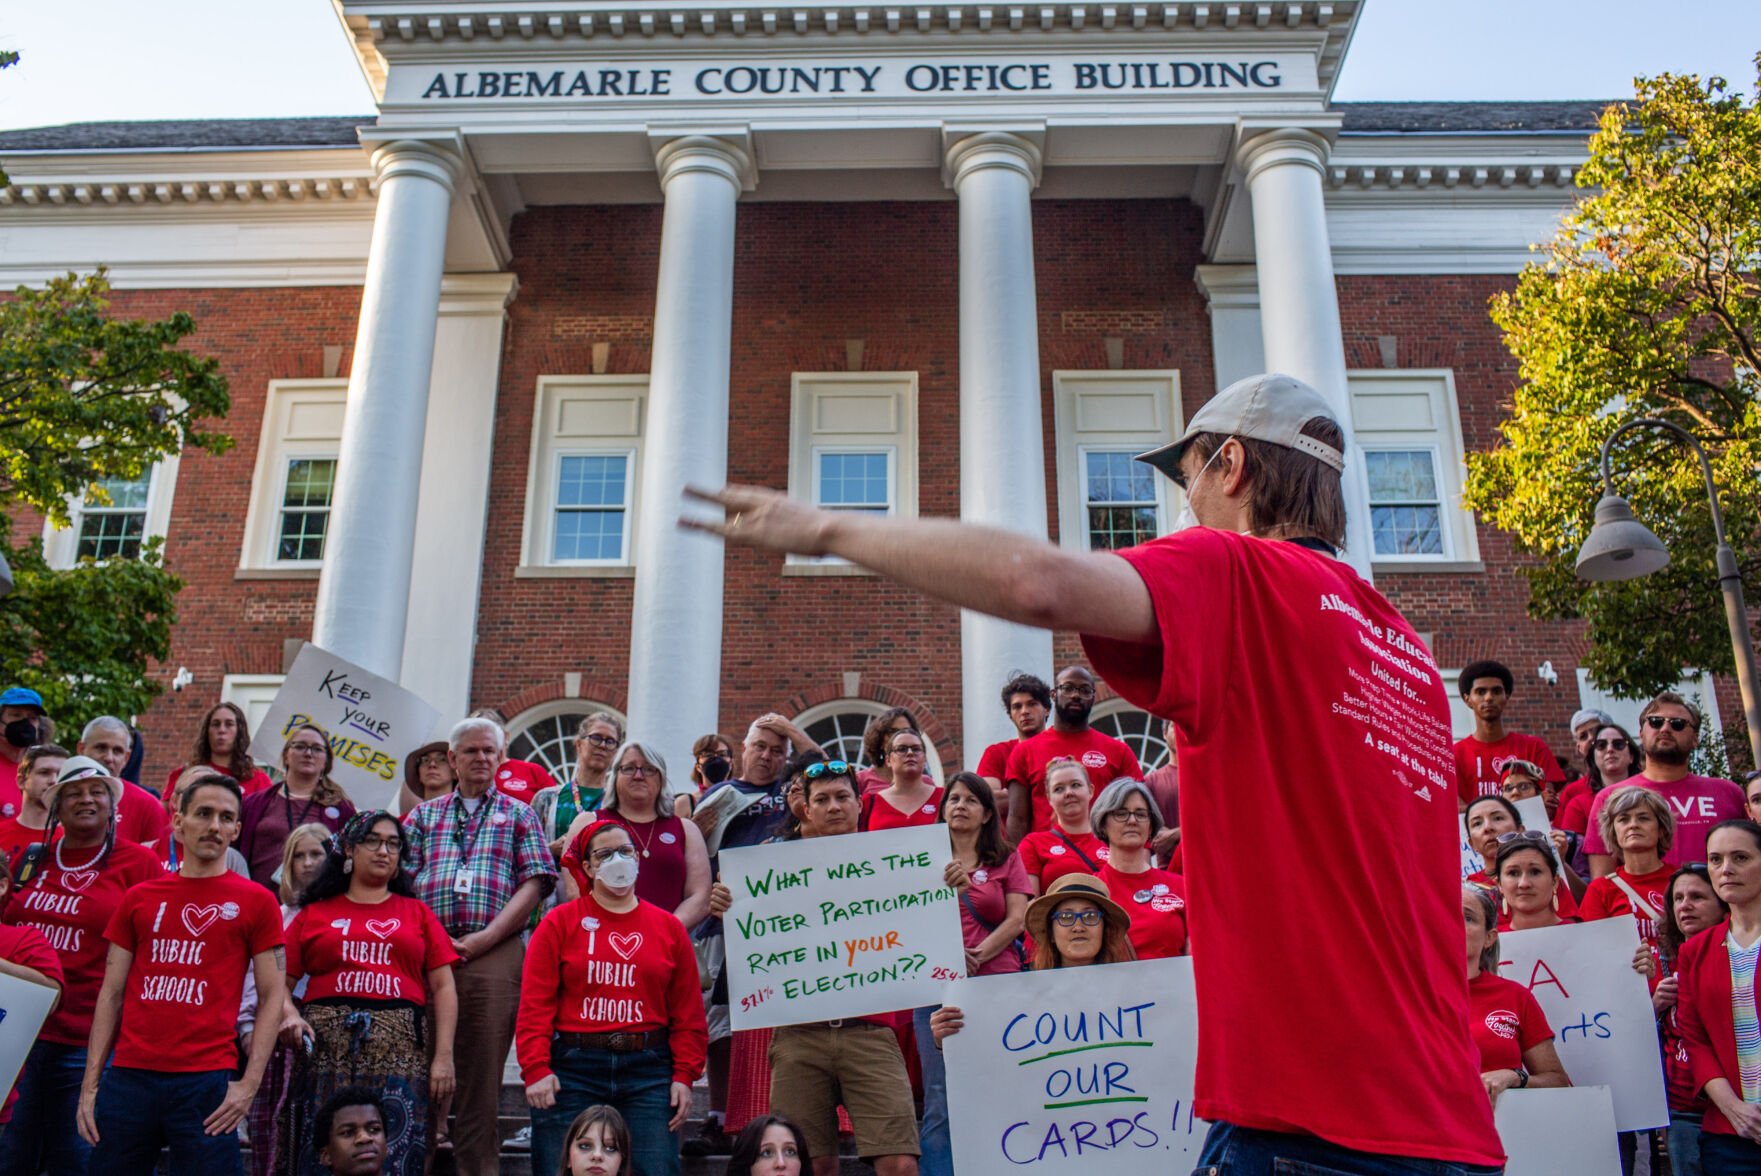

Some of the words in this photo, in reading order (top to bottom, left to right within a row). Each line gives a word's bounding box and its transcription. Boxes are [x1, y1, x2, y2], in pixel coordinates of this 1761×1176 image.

[421, 69, 671, 99] ALBEMARLE
[694, 66, 882, 96] COUNTY
[905, 63, 1052, 91] OFFICE
[1073, 61, 1281, 90] BUILDING
[318, 669, 372, 702] KEEP
[1371, 660, 1401, 692] United
[1332, 702, 1370, 724] Standard
[1343, 691, 1368, 708] Better
[339, 706, 391, 737] YOUR
[283, 714, 396, 780] PMISES
[1364, 732, 1374, 748] A
[1377, 740, 1400, 759] seat
[1401, 753, 1410, 767] at
[1411, 758, 1426, 776] the
[1428, 768, 1448, 790] table
[1476, 756, 1482, 778] I
[1666, 796, 1718, 818] VE
[35, 870, 49, 889] I
[745, 867, 814, 898] WHAT
[827, 861, 875, 881] WAS
[881, 851, 931, 871] THE
[23, 890, 83, 915] PUBLIC
[152, 901, 167, 933] I
[736, 911, 811, 940] VOTER
[819, 886, 957, 926] PARTICIPATION
[16, 921, 85, 952] OOLS
[151, 938, 206, 965] PUBLIC
[747, 947, 807, 974] RATE
[817, 941, 838, 962] IN
[844, 930, 904, 967] YOUR
[342, 940, 393, 966] PUBLIC
[335, 971, 401, 998] SCHOOLS
[587, 959, 637, 988] PUBLIC
[782, 953, 928, 1000] ELECTION??
[1498, 959, 1569, 998] A
[140, 974, 208, 1006] SCHOOLS
[579, 997, 643, 1023] SCHOOLS
[1002, 1002, 1155, 1052] COUNT
[1046, 1061, 1135, 1098] OUR
[1001, 1099, 1194, 1165] CARDS!!
